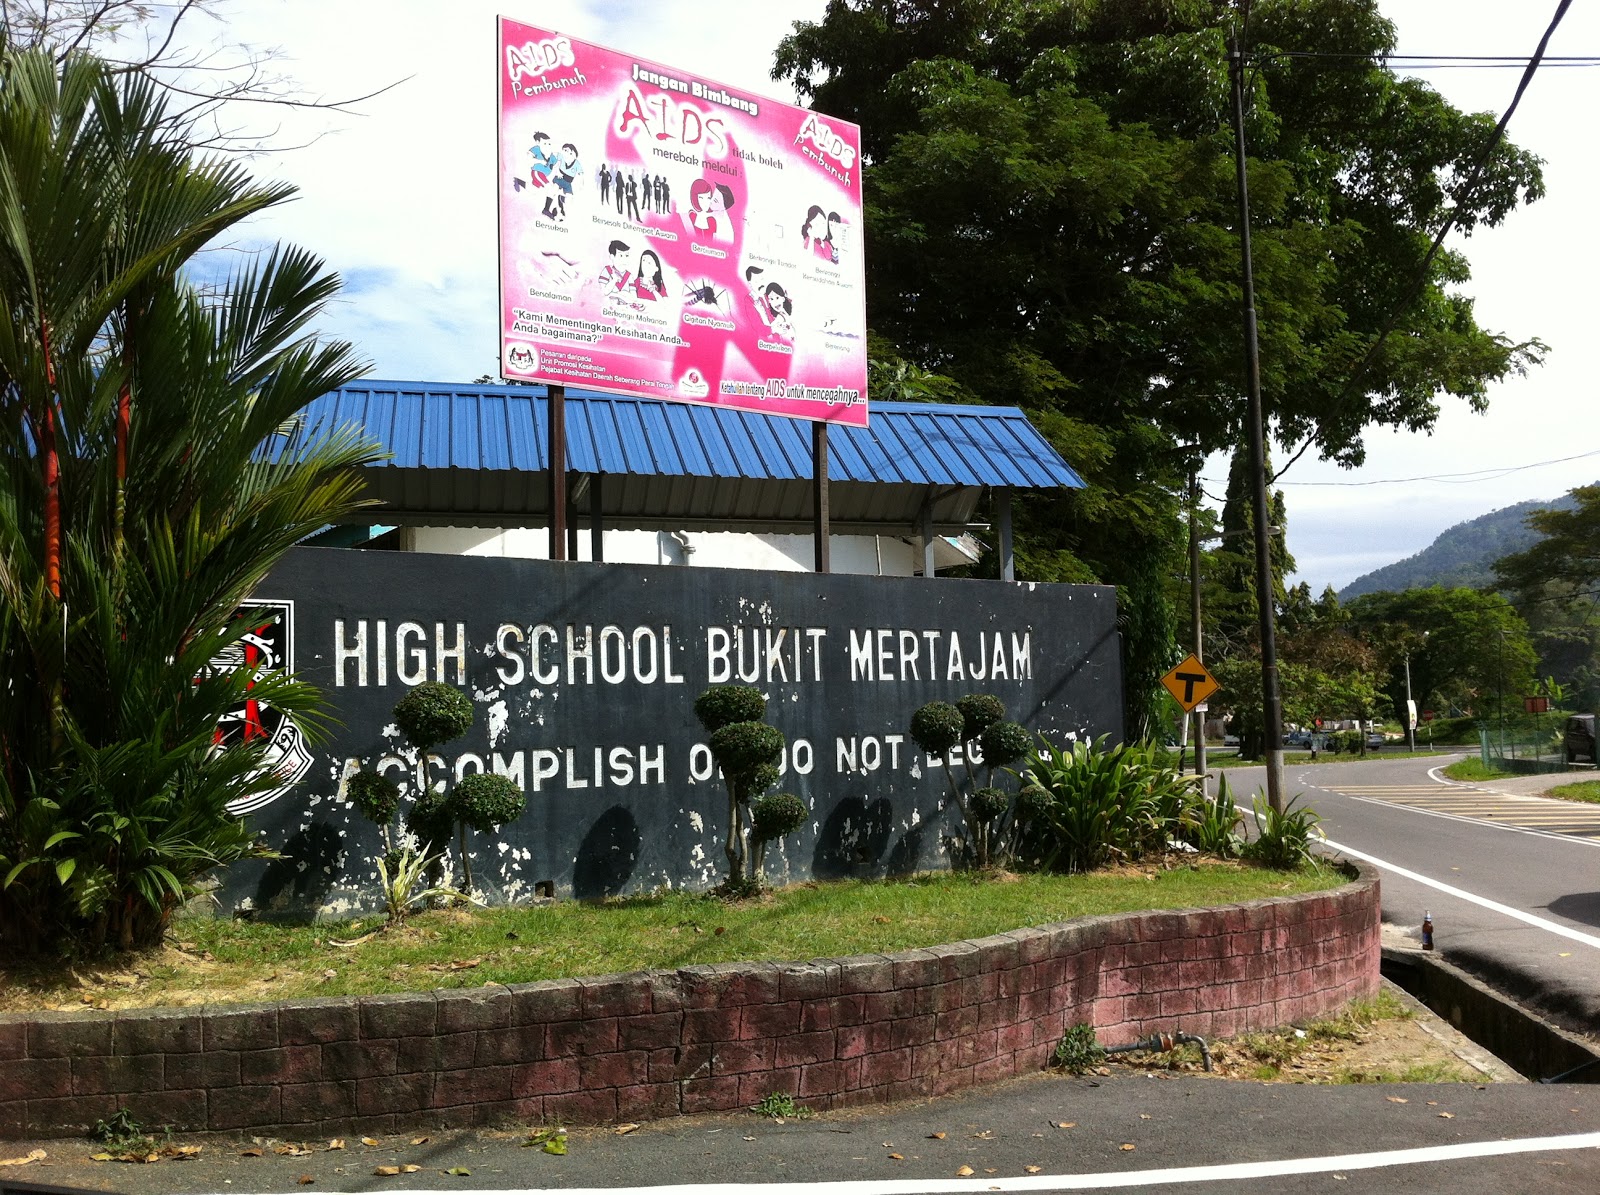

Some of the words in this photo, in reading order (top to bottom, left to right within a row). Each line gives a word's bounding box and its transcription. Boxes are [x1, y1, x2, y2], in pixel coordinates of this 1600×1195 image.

[507, 38, 574, 80] AIDS
[511, 67, 587, 100] Pembunuh
[632, 63, 689, 93] Jangan
[691, 81, 758, 116] Bimbang
[618, 87, 726, 154] AIDS
[801, 115, 855, 167] AIDS
[653, 147, 699, 166] merebak
[732, 147, 756, 162] tidak
[758, 154, 783, 170] boleh
[535, 220, 569, 234] Bersukan
[529, 288, 572, 302] Bersalaman
[513, 322, 539, 334] Anda
[545, 314, 612, 333] Mementingkan
[614, 325, 658, 341] Kesihatan
[683, 314, 707, 326] Gigitan
[766, 379, 785, 397] AIDS
[786, 385, 805, 398] untuk
[334, 618, 467, 687] HIGH
[496, 620, 685, 686] SCHOOL
[707, 626, 828, 684] BUKIT
[849, 628, 1032, 681] MERTAJAM
[689, 743, 726, 781] O
[836, 734, 904, 773] NOT
